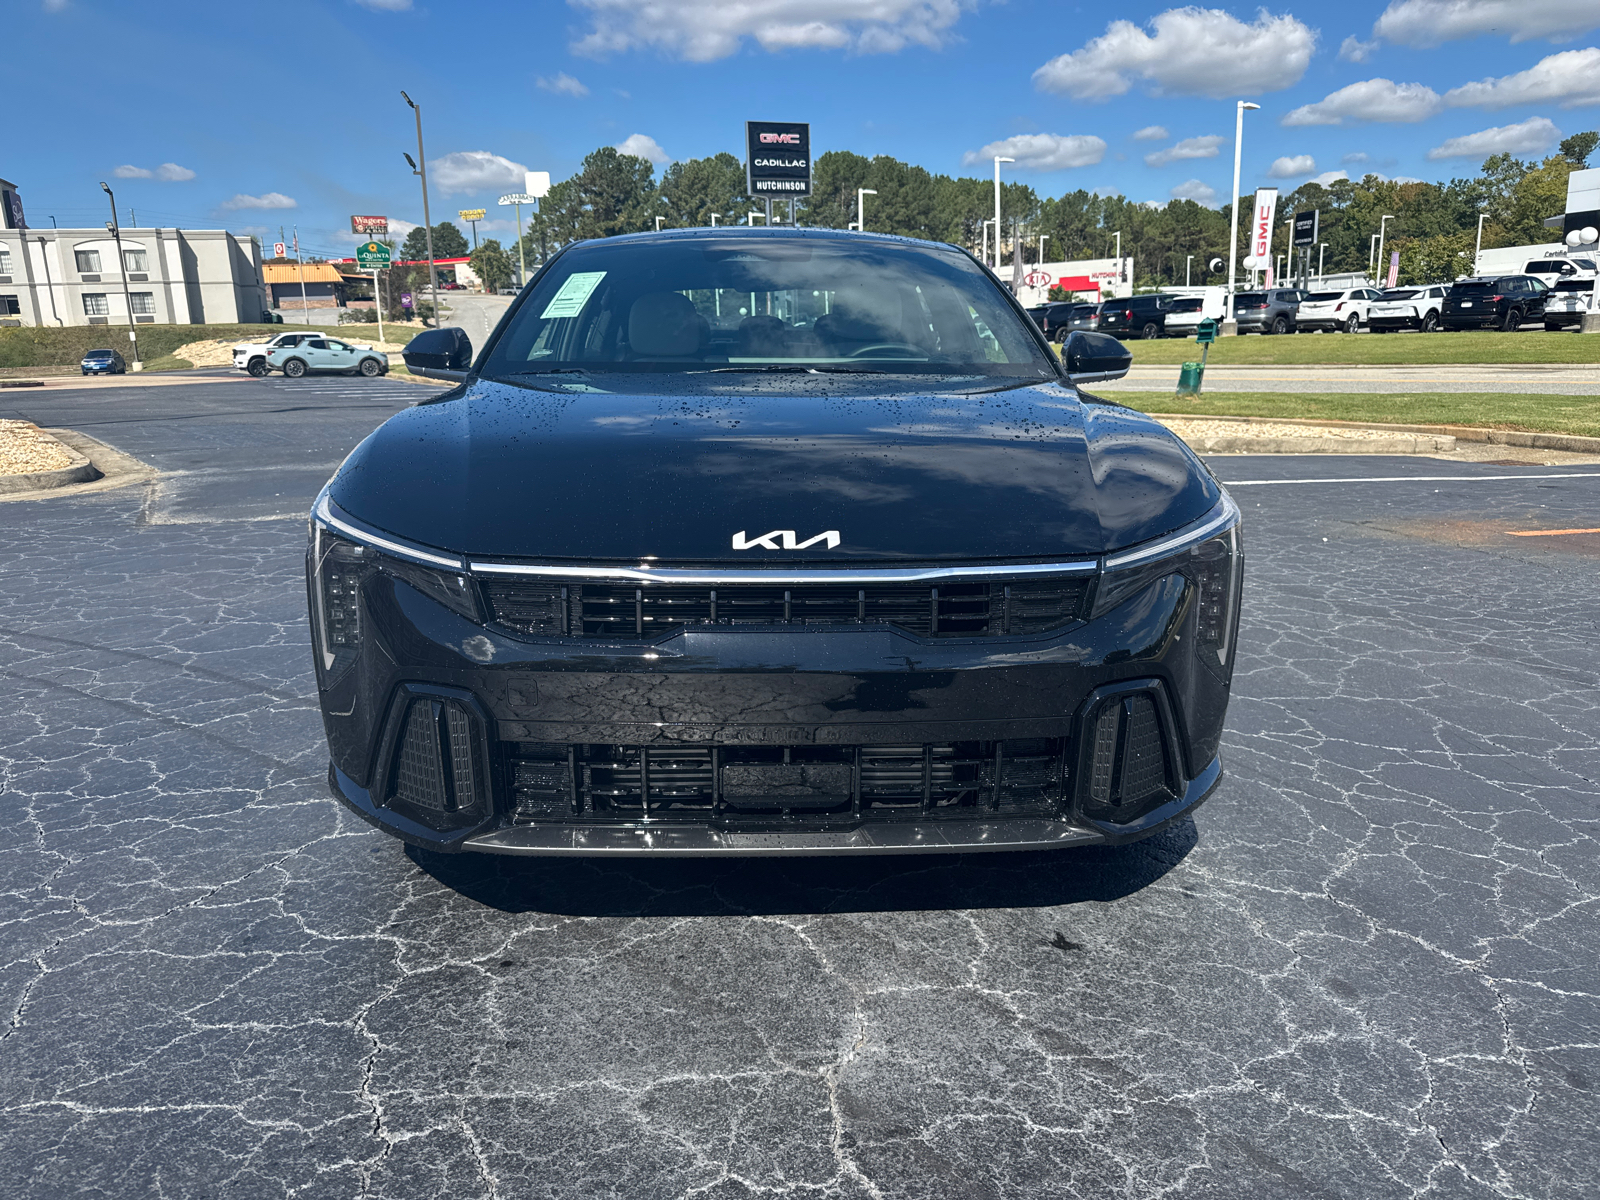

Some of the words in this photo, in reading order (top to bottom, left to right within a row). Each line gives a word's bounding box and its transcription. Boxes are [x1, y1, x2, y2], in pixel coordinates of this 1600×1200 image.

[760, 133, 800, 144] GMC
[754, 159, 806, 167] CADILLAC
[757, 181, 806, 191] HUTCHINSON
[354, 216, 386, 225] Wagers
[1256, 206, 1270, 256] GMC
[732, 530, 841, 550] KIA
